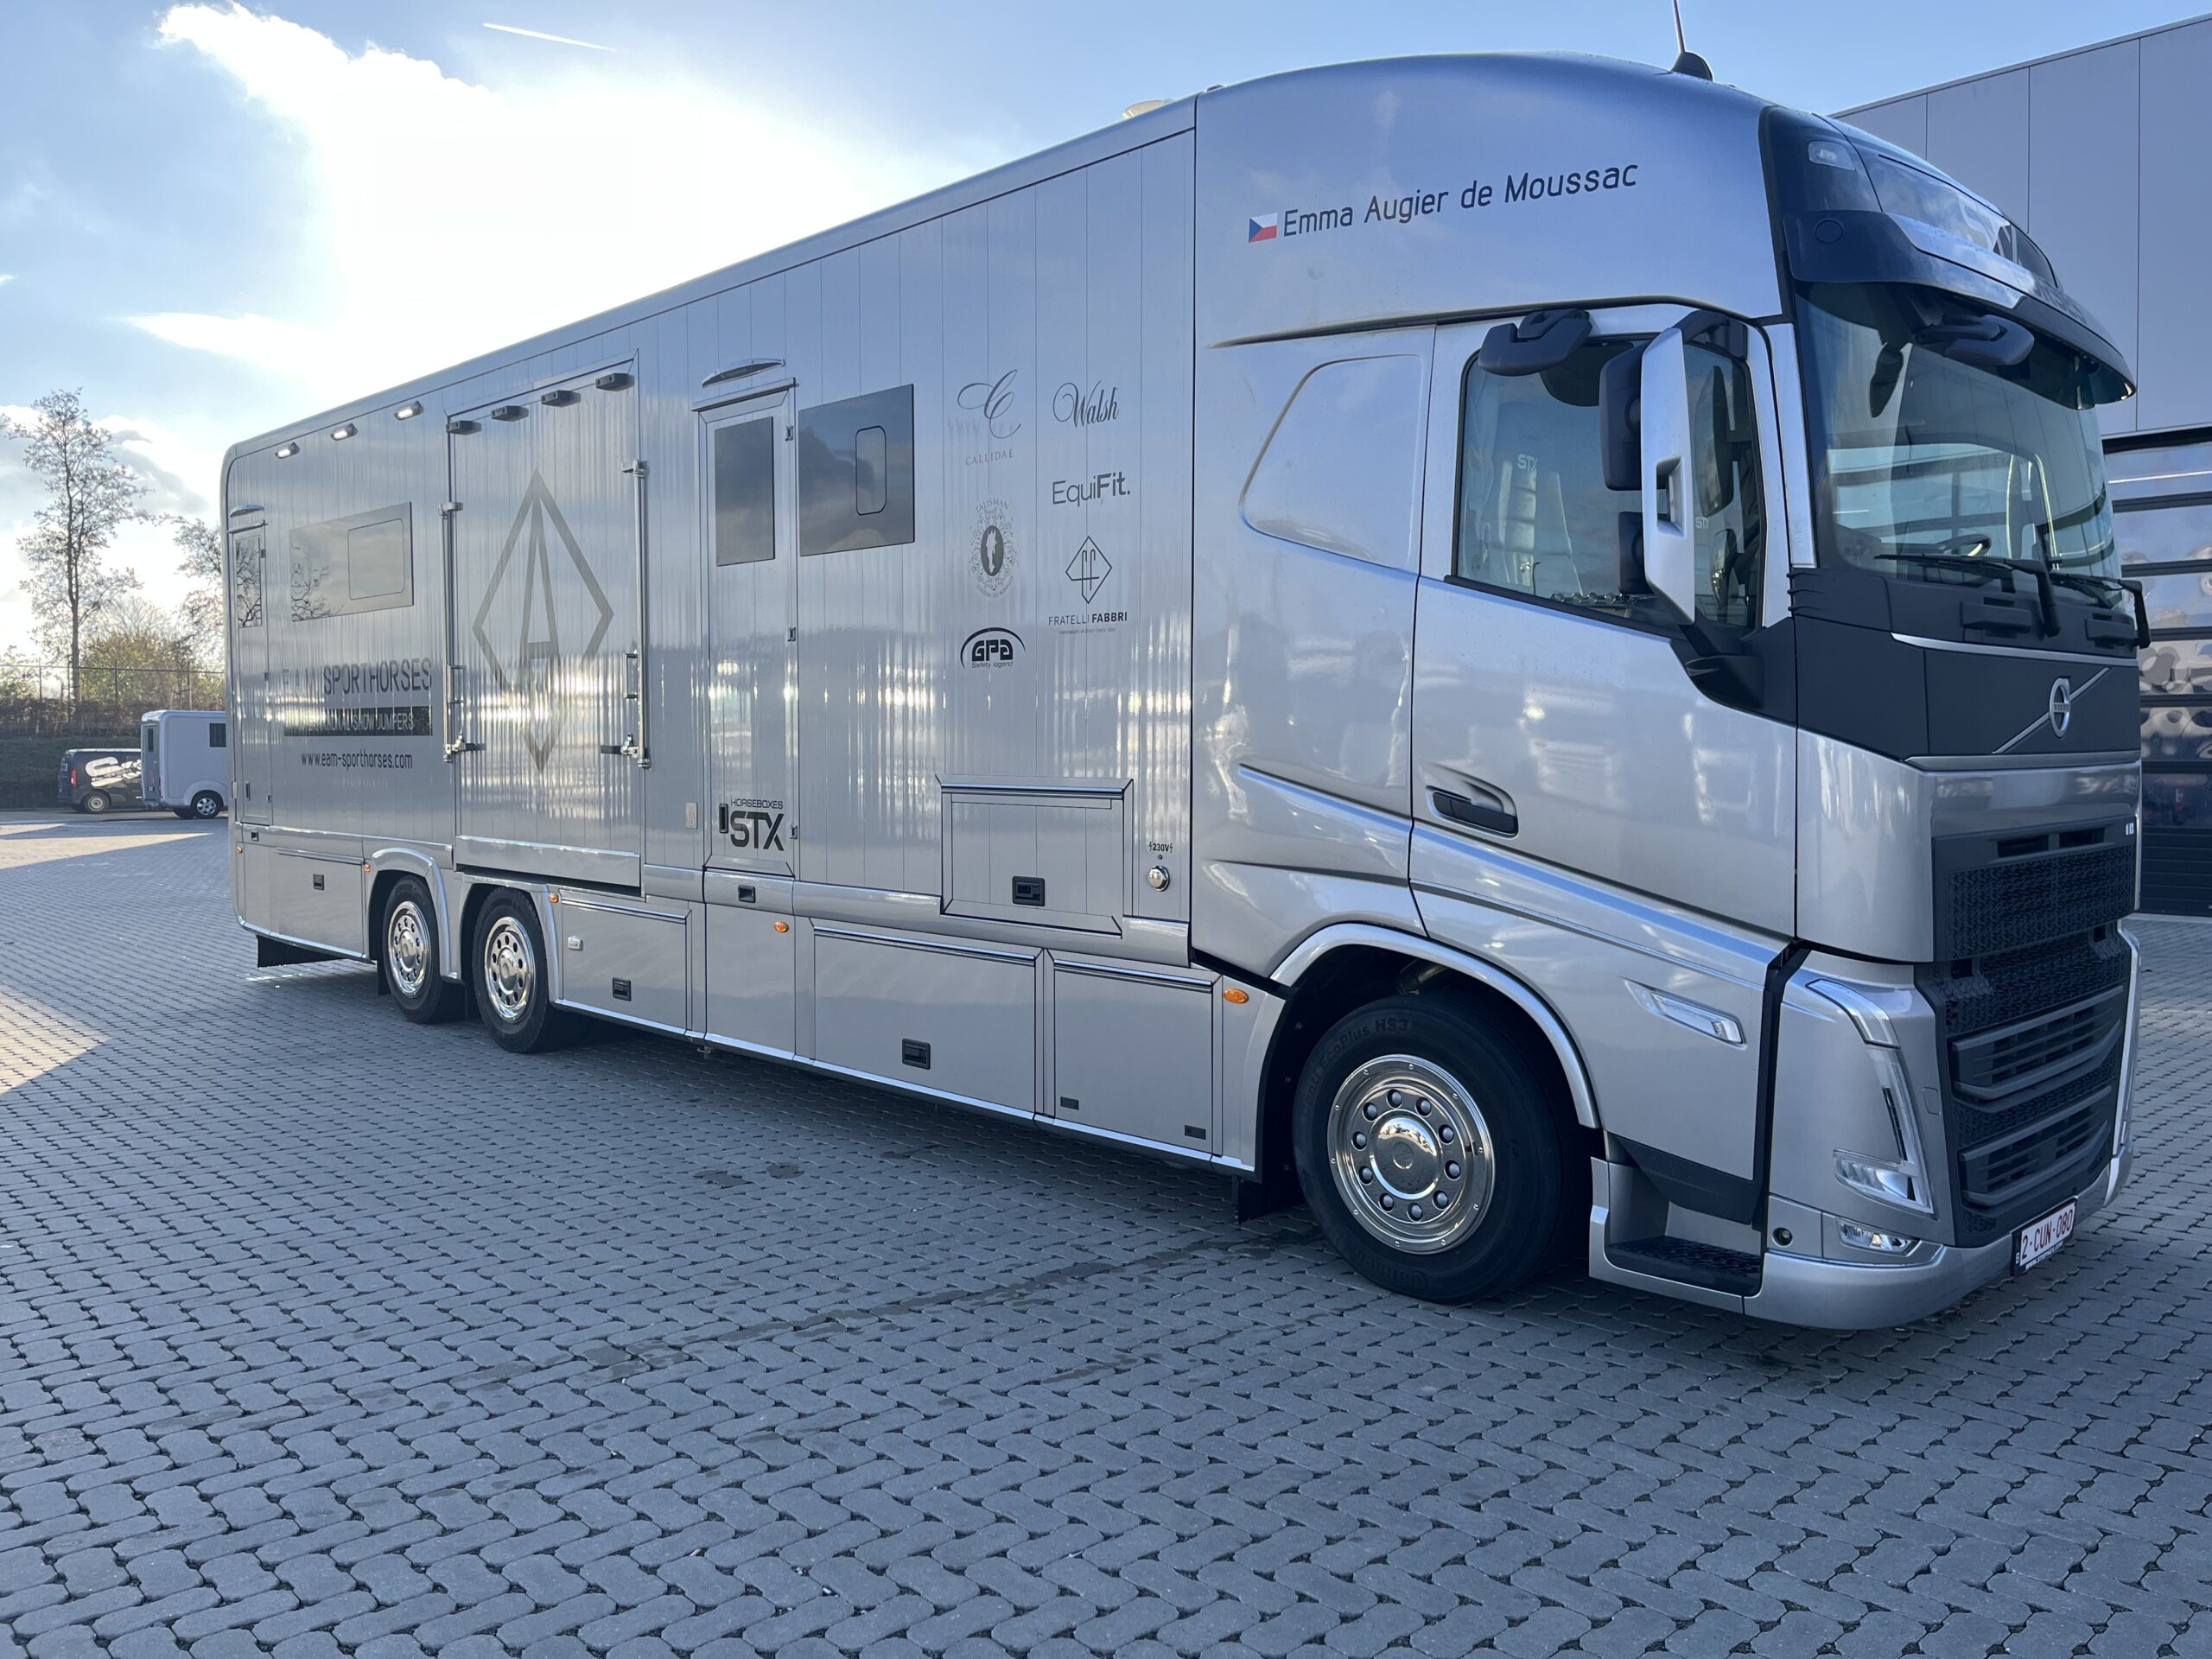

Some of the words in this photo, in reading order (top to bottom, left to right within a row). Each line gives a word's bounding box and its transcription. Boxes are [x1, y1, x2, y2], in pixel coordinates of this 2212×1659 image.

[1283, 207, 1352, 237] Emma
[1363, 189, 1448, 225] Augier
[1460, 180, 1492, 209] de
[1504, 163, 1638, 203] Moussac
[1052, 379, 1119, 429] Walsh
[965, 448, 1014, 466] CALLIDAE
[1052, 472, 1131, 507] EquiFit.
[976, 498, 1009, 513] TALISMAN
[1048, 614, 1090, 626] FRATELLI
[1091, 612, 1128, 623] FABBRI
[972, 639, 1013, 661] GPA
[994, 660, 1013, 669] legend
[323, 658, 432, 695] SPORTHORSES
[353, 714, 374, 731] SHOW
[377, 712, 414, 731] JUMPERS
[301, 748, 413, 771] www.eam-sporthorses.com
[730, 798, 784, 810] HORSEBOXES
[730, 810, 785, 851] STX
[1153, 842, 1169, 852] 230V
[1318, 1025, 1370, 1070] EcoPlus
[1375, 1018, 1409, 1033] HS3
[2022, 1209, 2073, 1260] 2-CUN-080
